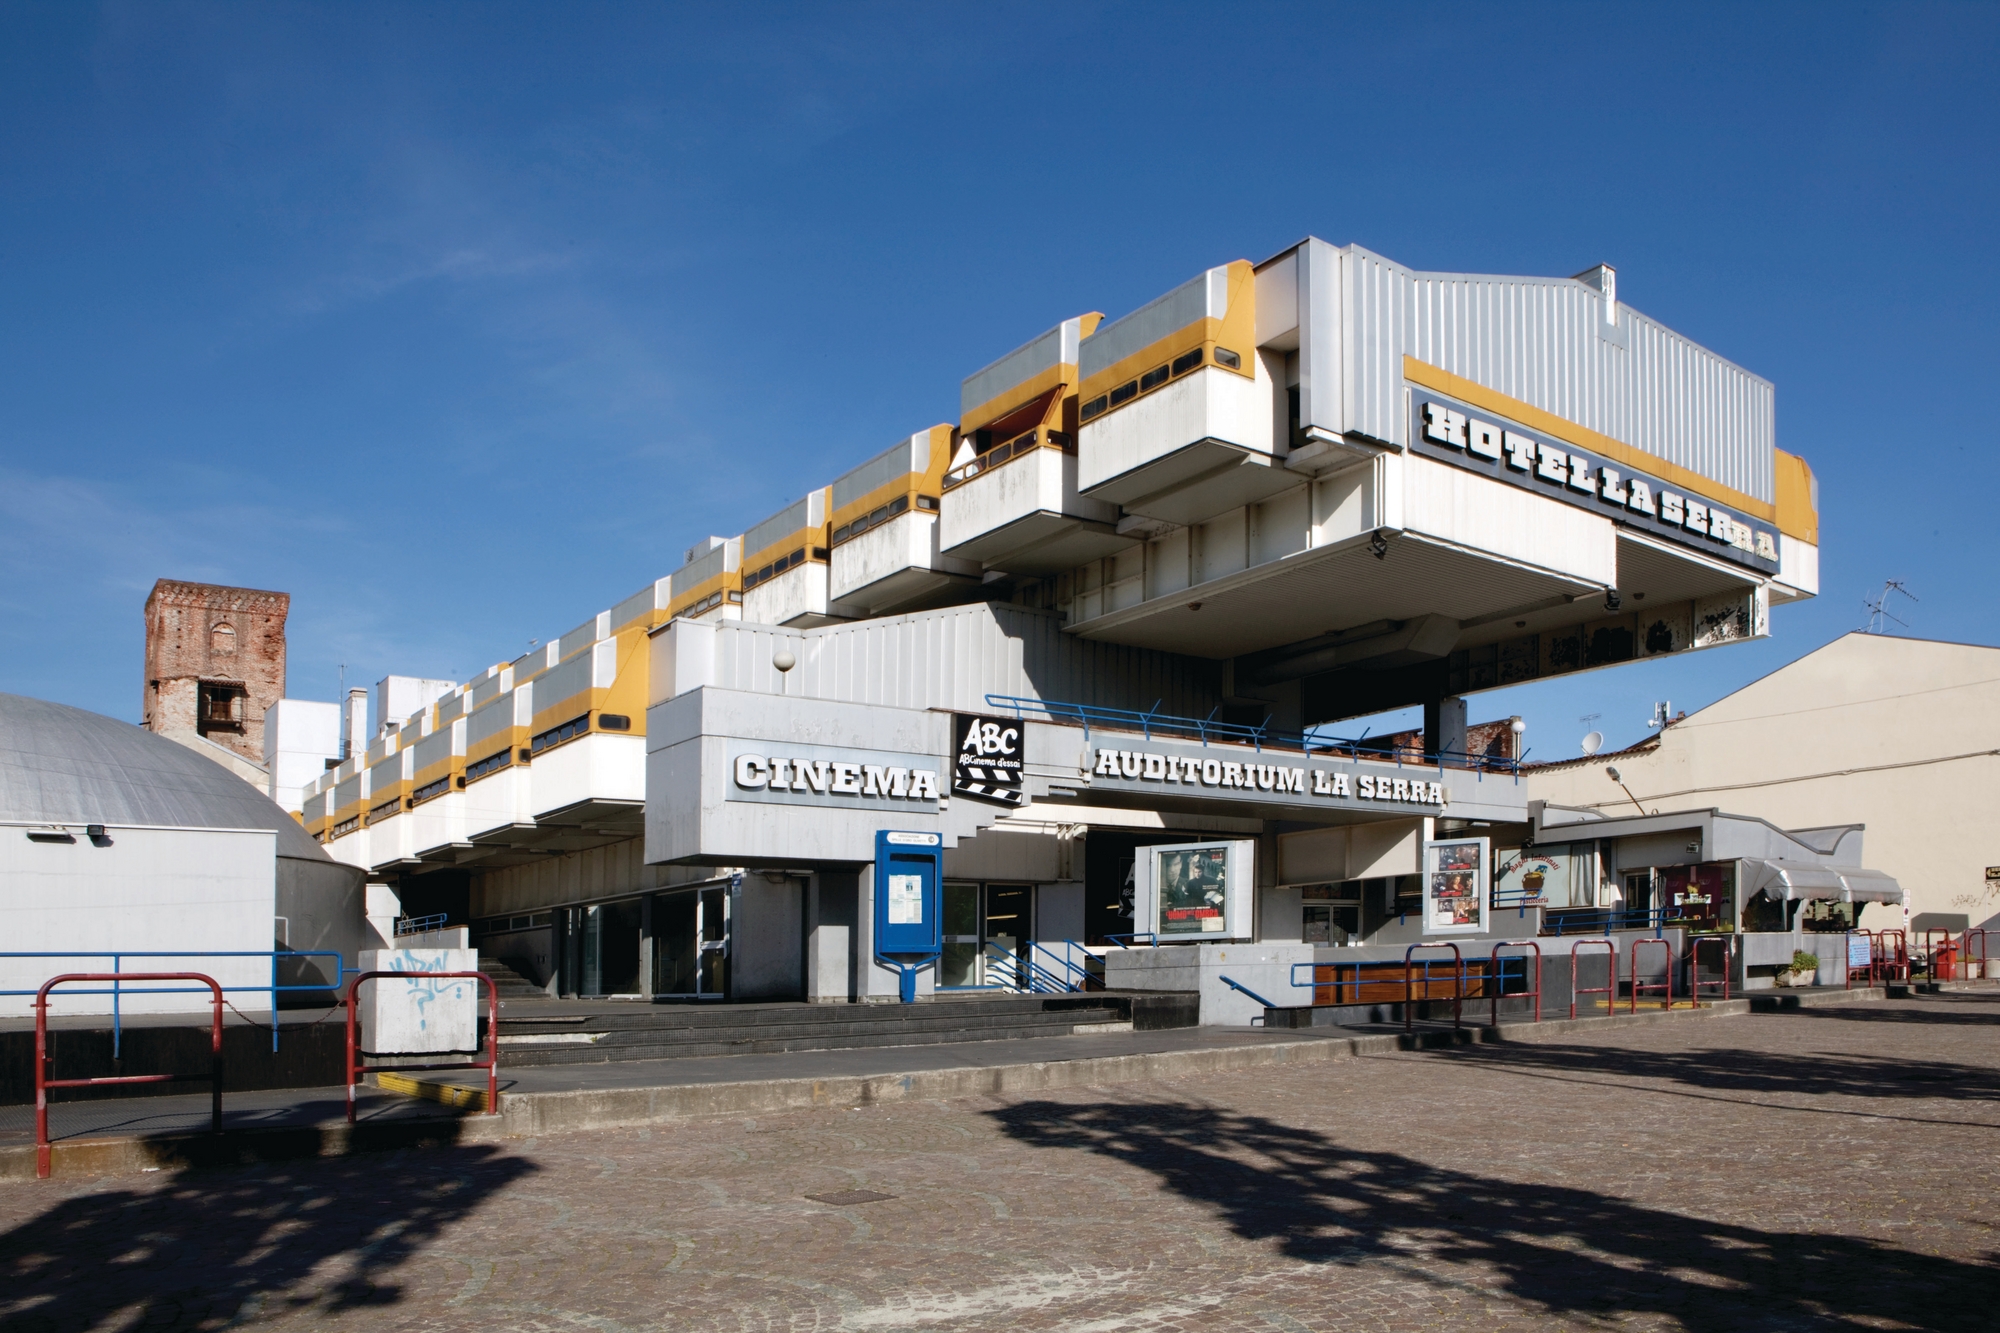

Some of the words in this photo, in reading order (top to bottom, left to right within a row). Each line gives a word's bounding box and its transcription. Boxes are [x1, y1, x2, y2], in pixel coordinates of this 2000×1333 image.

[1422, 401, 1597, 496] HOTEL
[1598, 466, 1656, 517] LA
[1657, 490, 1779, 563] SERRA
[962, 718, 1018, 756] ABC
[734, 753, 939, 800] CINEMA
[997, 757, 1021, 768] d'essai
[1095, 748, 1305, 793] AUDITORIUM
[1310, 768, 1351, 796] LA
[1357, 774, 1444, 805] SERRA
